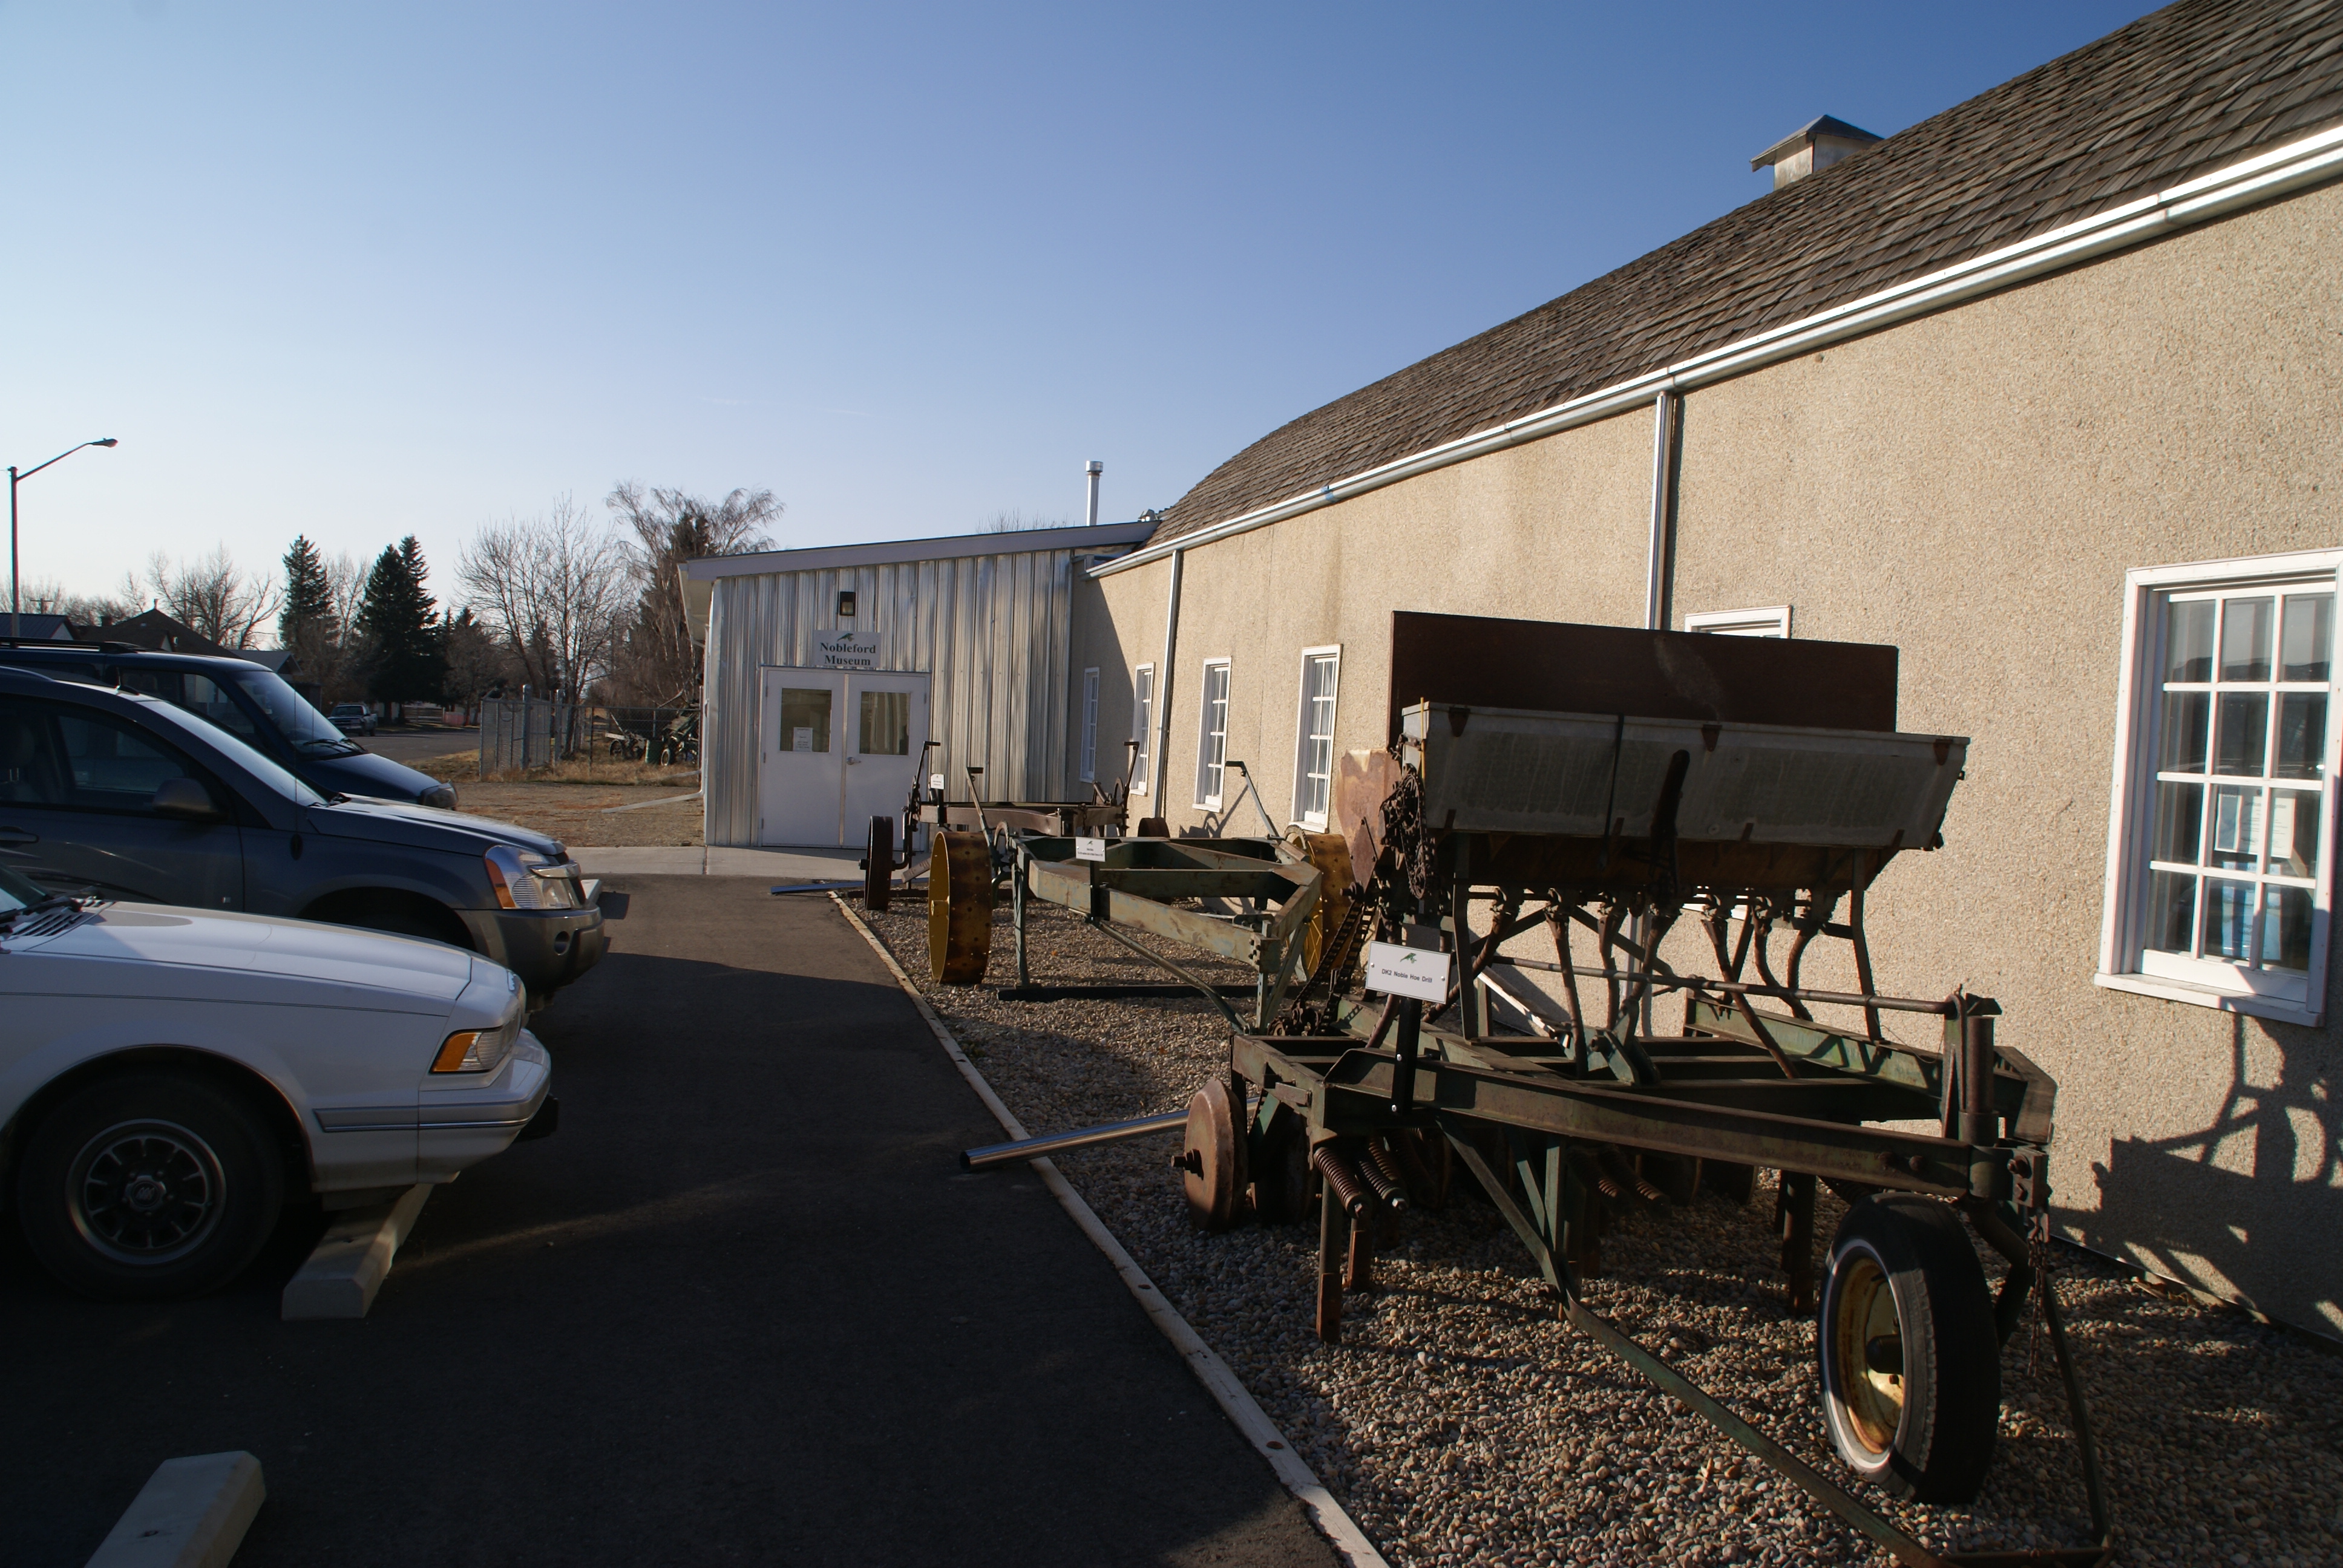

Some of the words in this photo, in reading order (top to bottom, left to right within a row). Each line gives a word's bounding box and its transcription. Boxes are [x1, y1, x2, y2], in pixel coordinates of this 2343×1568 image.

[820, 642, 876, 654] Nobleford
[824, 655, 871, 666] Museum
[1394, 970, 1408, 979] Noble
